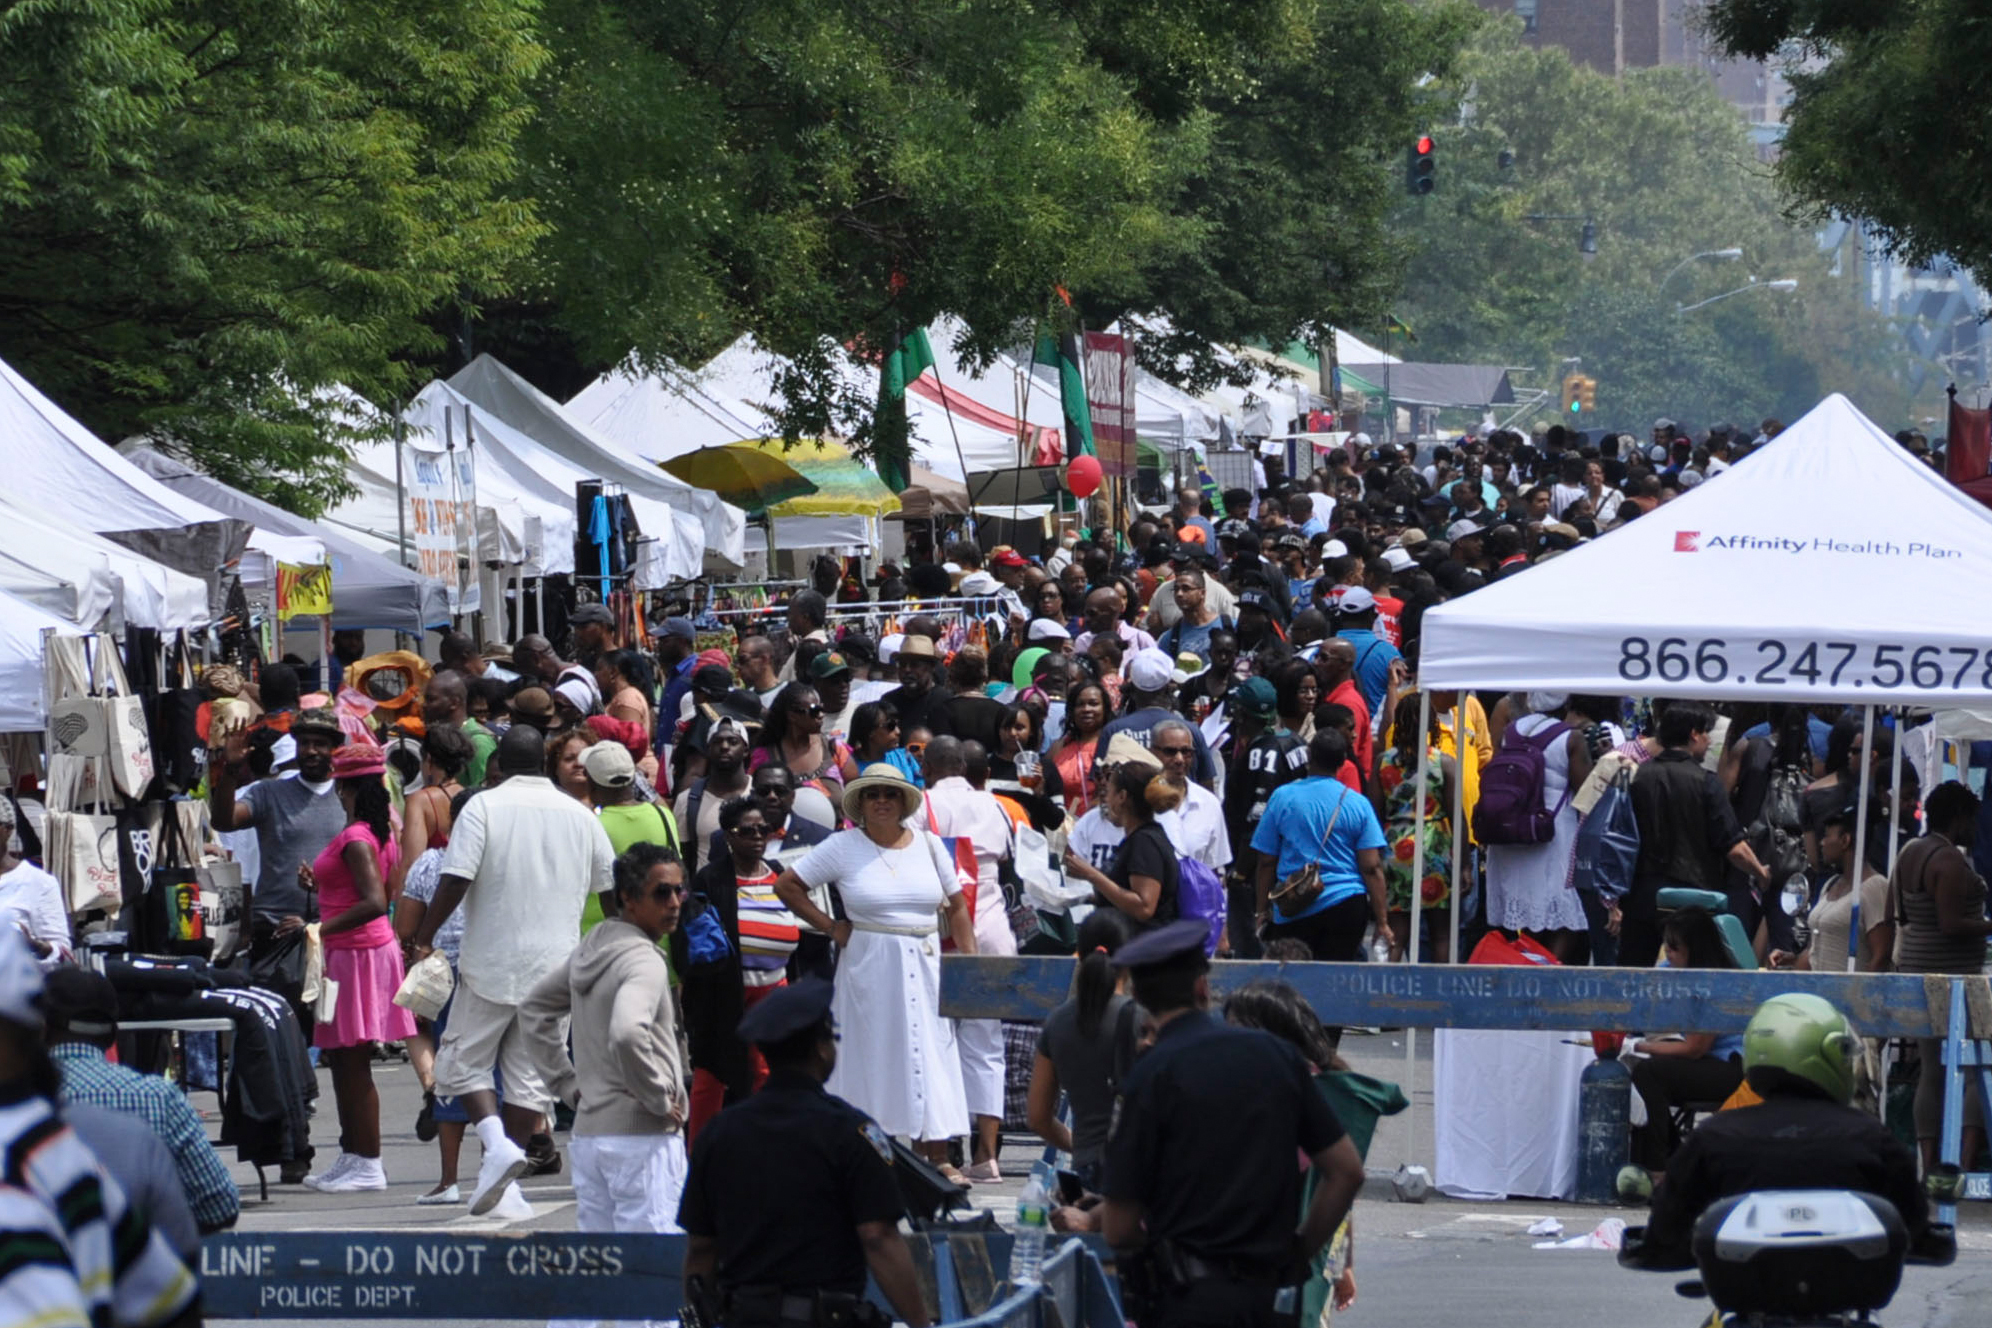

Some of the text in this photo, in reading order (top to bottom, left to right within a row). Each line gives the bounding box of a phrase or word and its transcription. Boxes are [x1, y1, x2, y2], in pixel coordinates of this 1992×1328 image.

[1706, 535, 1962, 559] Affinity Health Plan
[1248, 747, 1277, 774] 81
[1334, 973, 1422, 996] POLICE
[1438, 975, 1493, 997] LINE
[1507, 976, 1541, 997] DO
[1557, 976, 1602, 998] NOT
[202, 1245, 276, 1276] LINE
[346, 1245, 395, 1276] DO
[415, 1245, 487, 1276] NOT
[507, 1245, 624, 1277] CROSS
[261, 1286, 420, 1307] POLICE DEPT.
